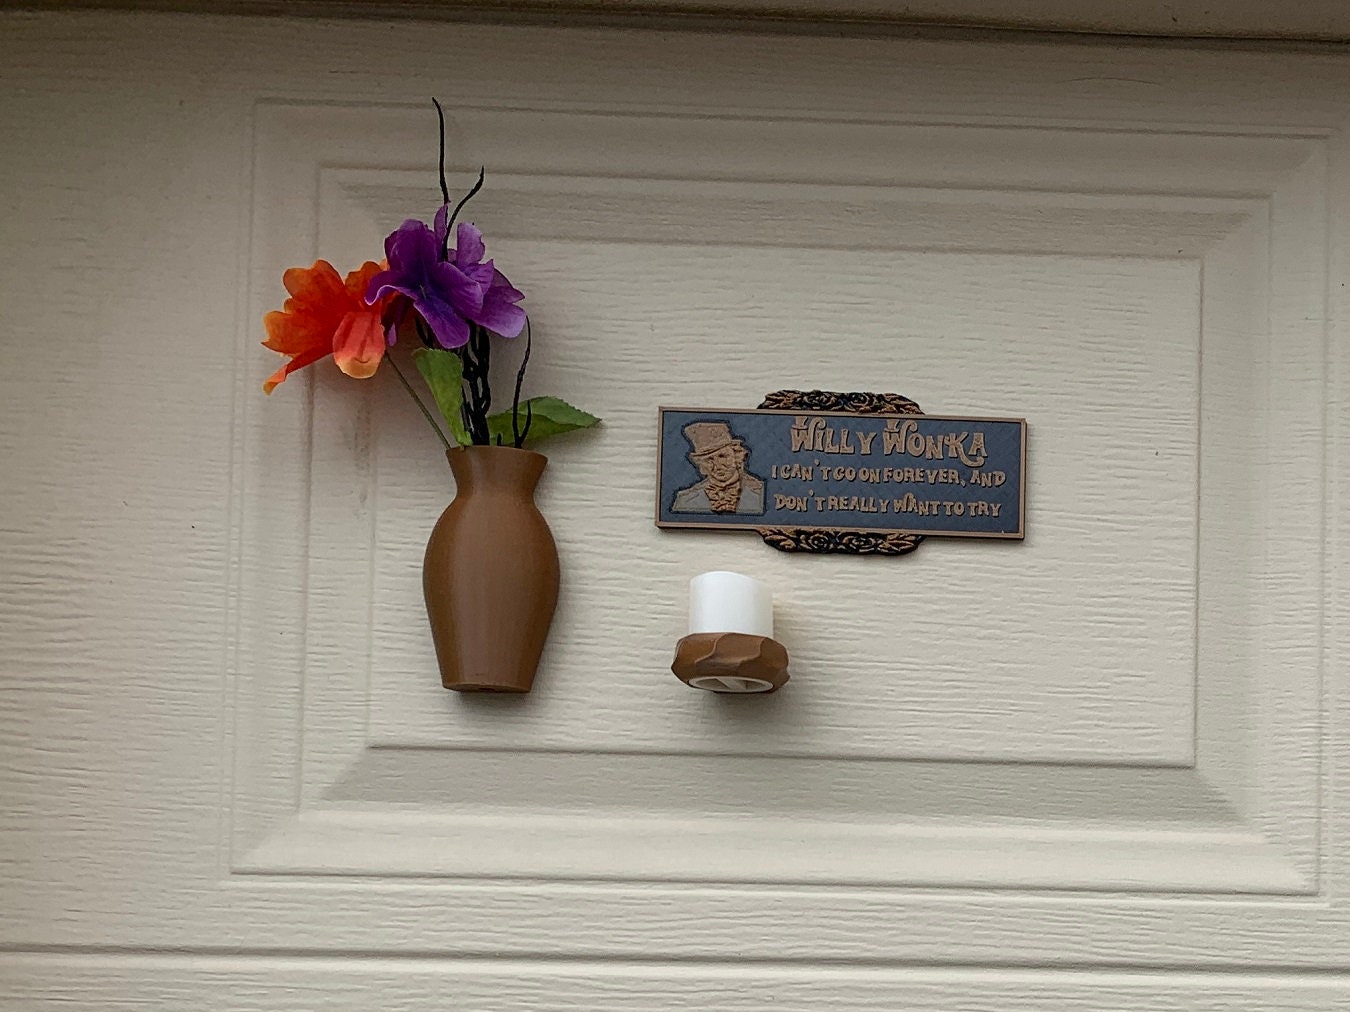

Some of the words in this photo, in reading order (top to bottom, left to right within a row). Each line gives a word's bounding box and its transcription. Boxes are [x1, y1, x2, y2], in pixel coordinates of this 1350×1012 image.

[771, 464, 778, 478] I
[835, 467, 857, 481] GO
[858, 467, 881, 482] ON
[883, 468, 967, 487] FOREVER,
[970, 470, 1006, 487] AND
[828, 496, 890, 513] REALLY
[894, 493, 942, 516] WANT
[943, 501, 965, 515] TO
[967, 501, 1002, 517] TRY
